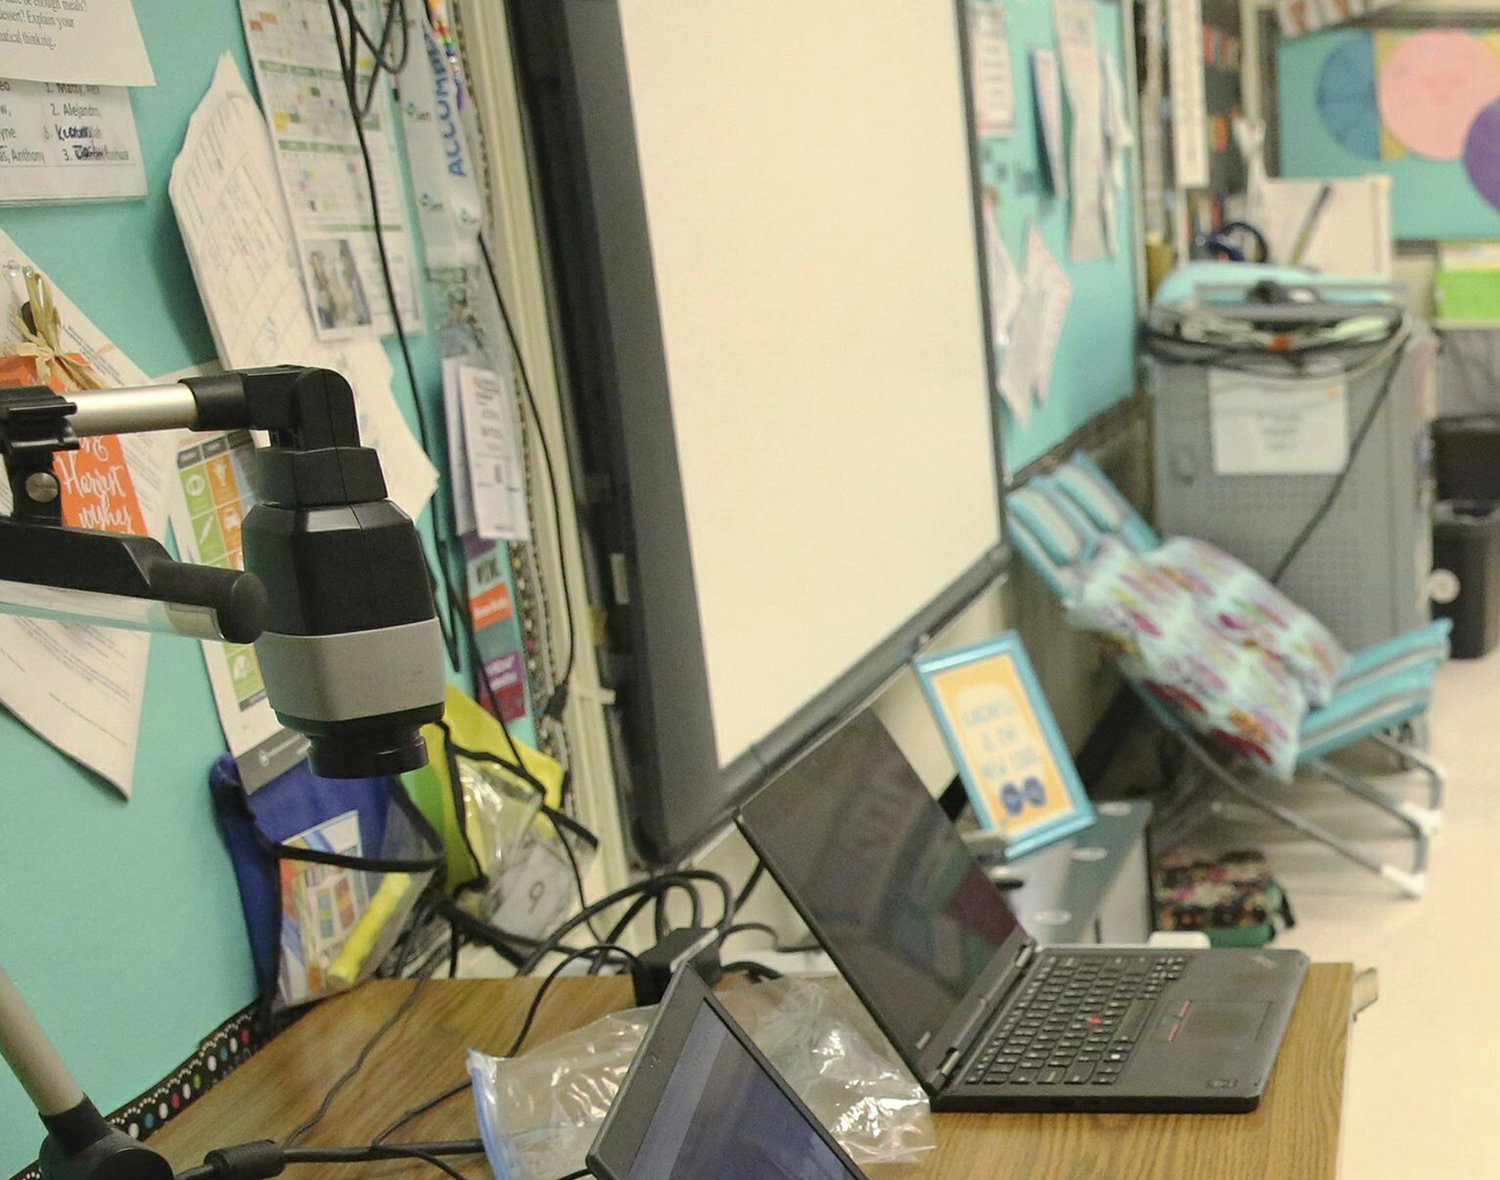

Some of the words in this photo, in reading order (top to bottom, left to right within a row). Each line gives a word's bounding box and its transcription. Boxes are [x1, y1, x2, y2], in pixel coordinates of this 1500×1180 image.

[27, 11, 56, 28] Explain
[57, 18, 75, 30] your
[22, 32, 56, 50] thinking.
[11, 148, 46, 164] Anthony
